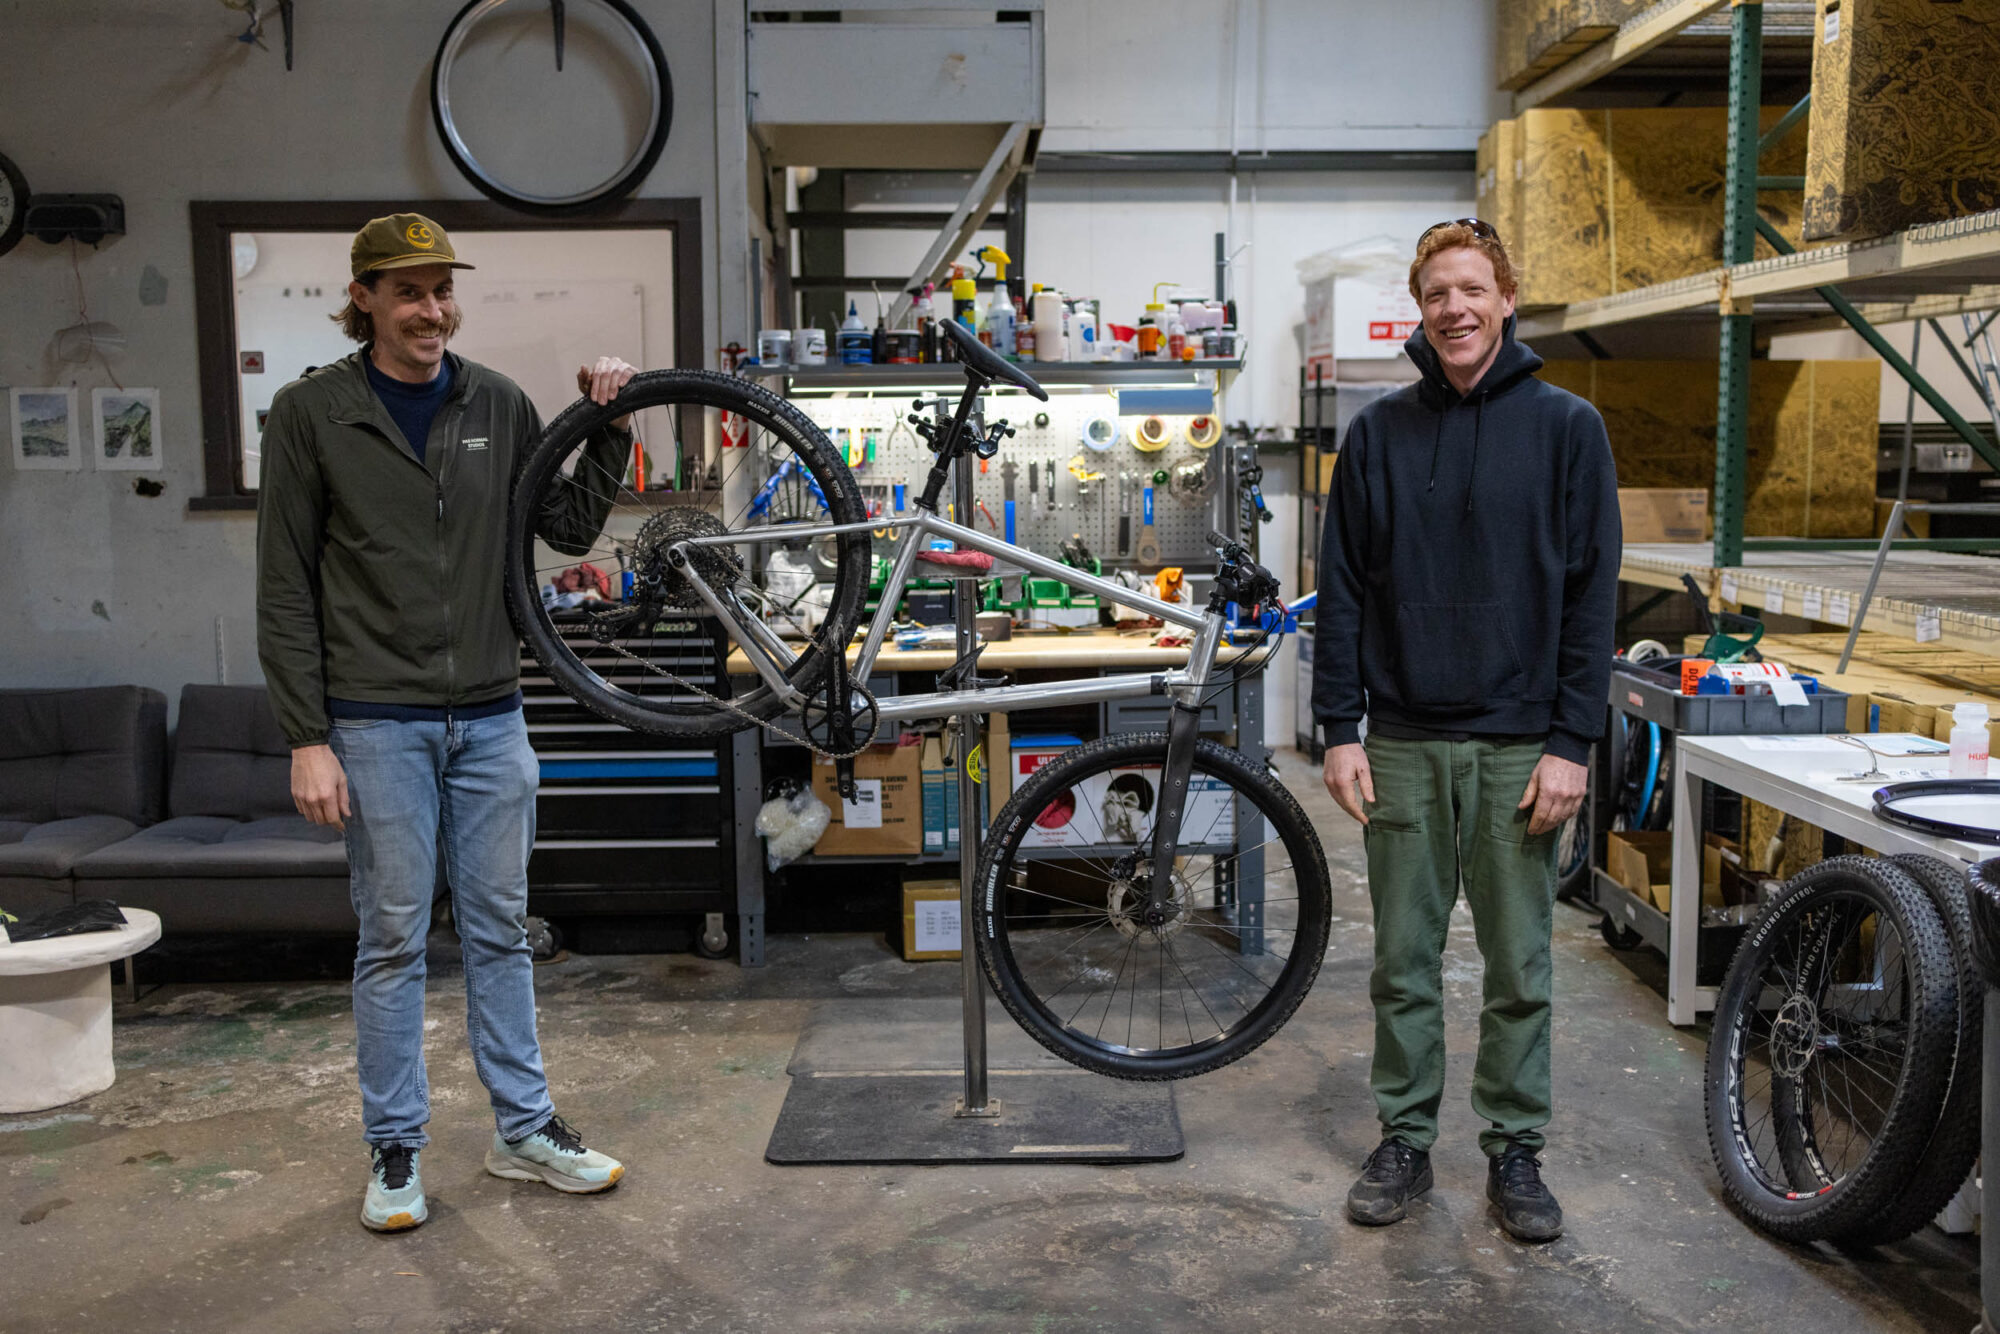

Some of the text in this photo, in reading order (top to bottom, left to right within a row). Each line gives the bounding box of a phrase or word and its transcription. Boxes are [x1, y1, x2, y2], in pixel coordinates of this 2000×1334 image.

[747, 400, 815, 450] MAXXIS RAMBLER
[1688, 668, 1699, 682] DO
[985, 864, 999, 912] RAMBLER
[987, 916, 995, 938] MAXXIS
[1753, 885, 1816, 947] GROUND CONTROL
